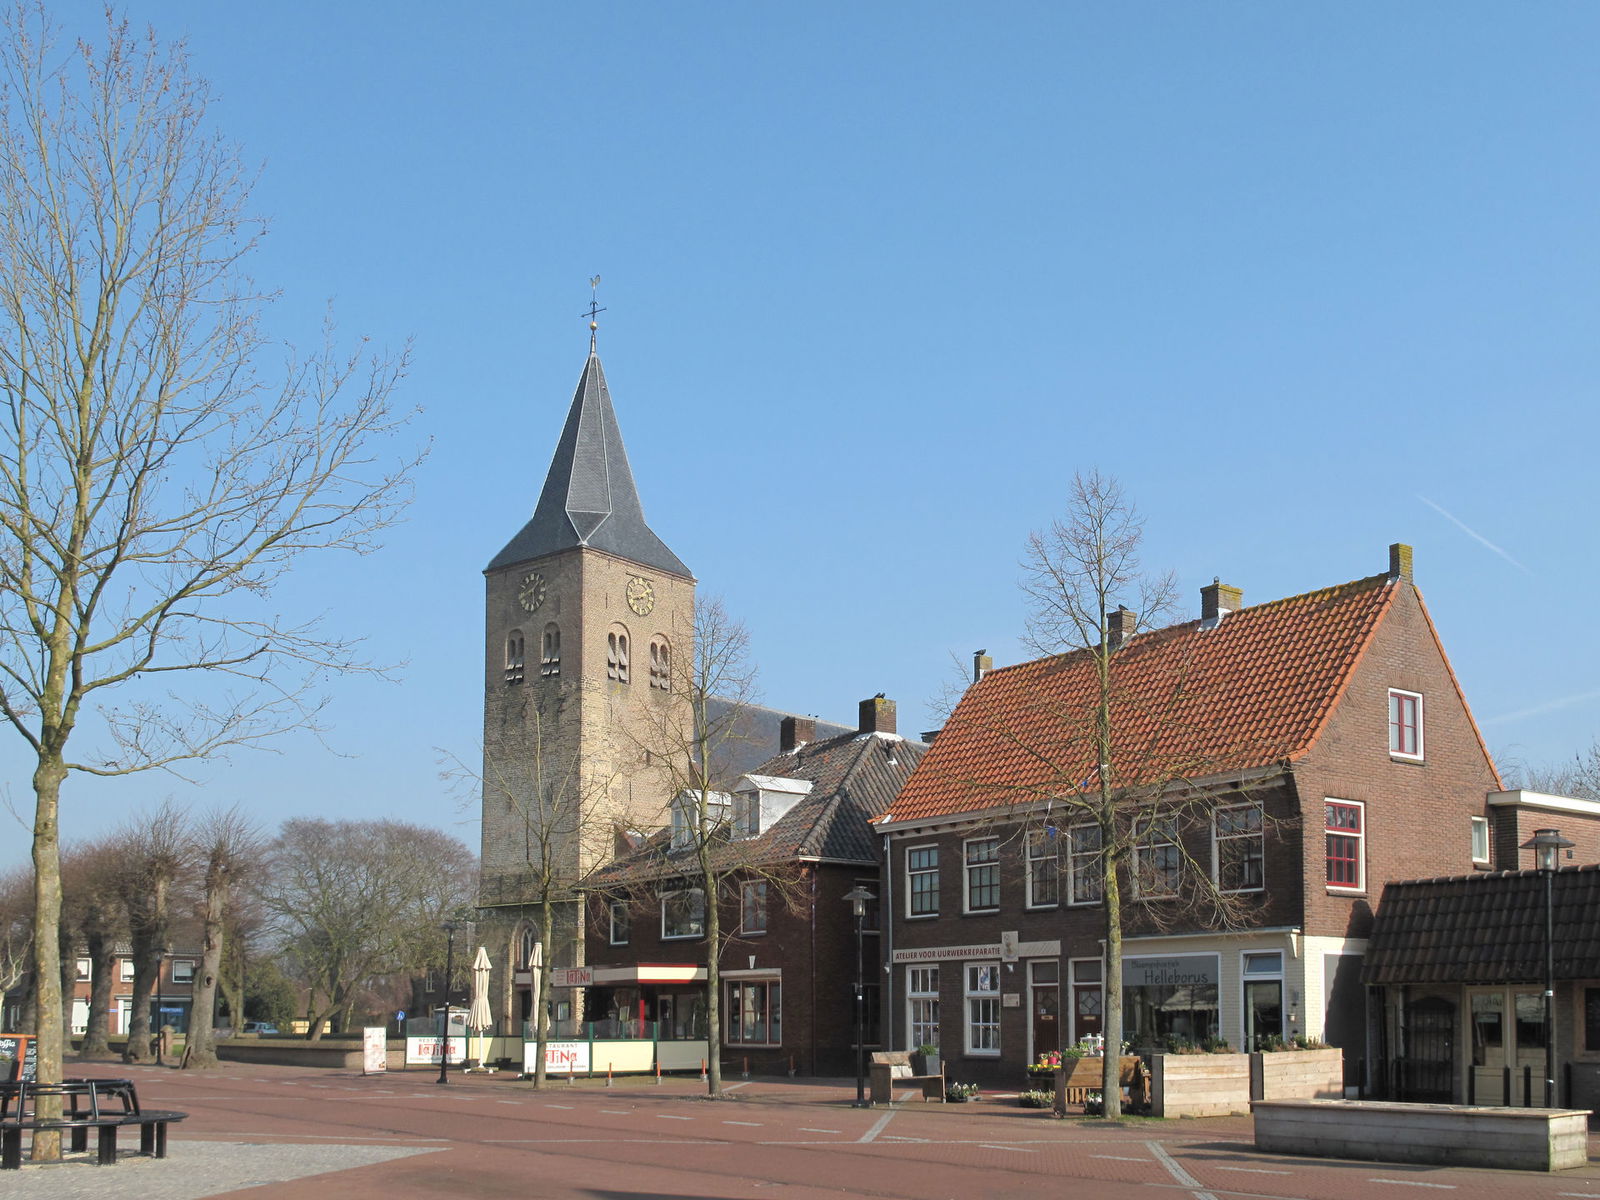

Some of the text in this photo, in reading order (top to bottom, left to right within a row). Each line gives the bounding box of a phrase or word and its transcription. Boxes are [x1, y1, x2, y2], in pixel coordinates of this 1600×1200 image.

[895, 946, 1001, 960] ATELIER VOOR UURWERKREPARATIE
[1144, 968, 1209, 985] Helleborus
